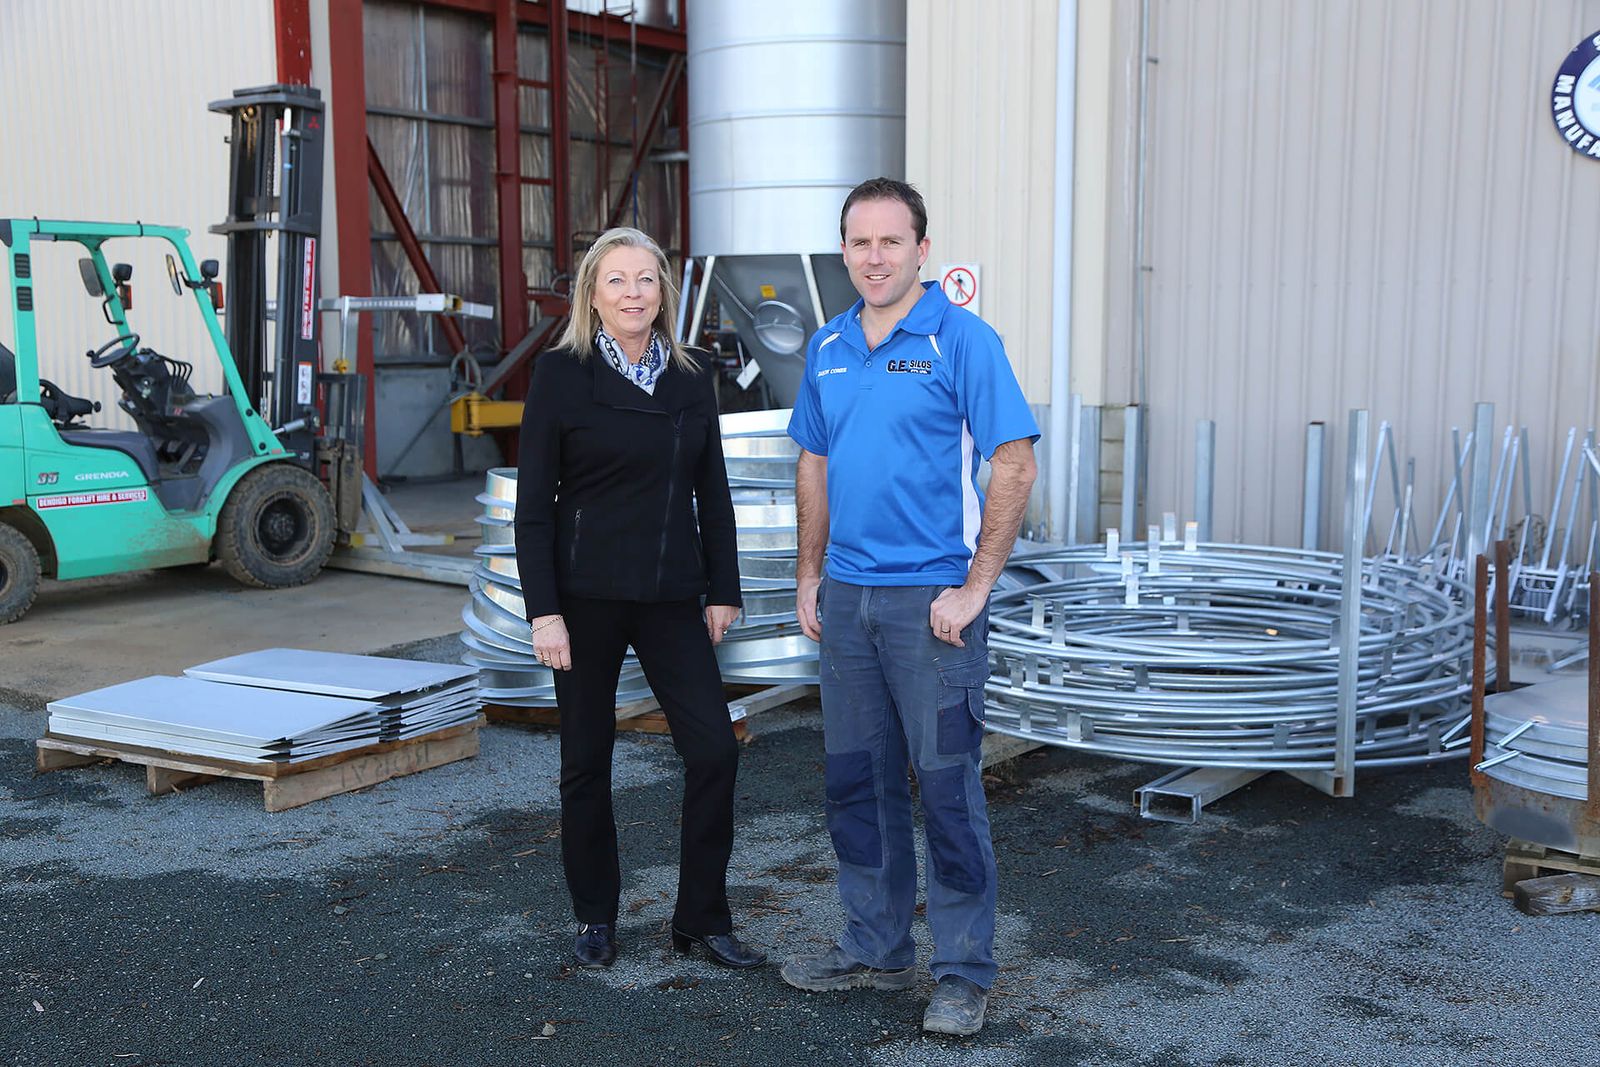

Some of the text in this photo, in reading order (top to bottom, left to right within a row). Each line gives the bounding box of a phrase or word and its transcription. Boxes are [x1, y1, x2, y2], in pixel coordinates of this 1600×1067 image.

[909, 359, 932, 369] SILOS
[74, 471, 129, 481] GRENDIA
[67, 494, 96, 505] FORKLIFT
